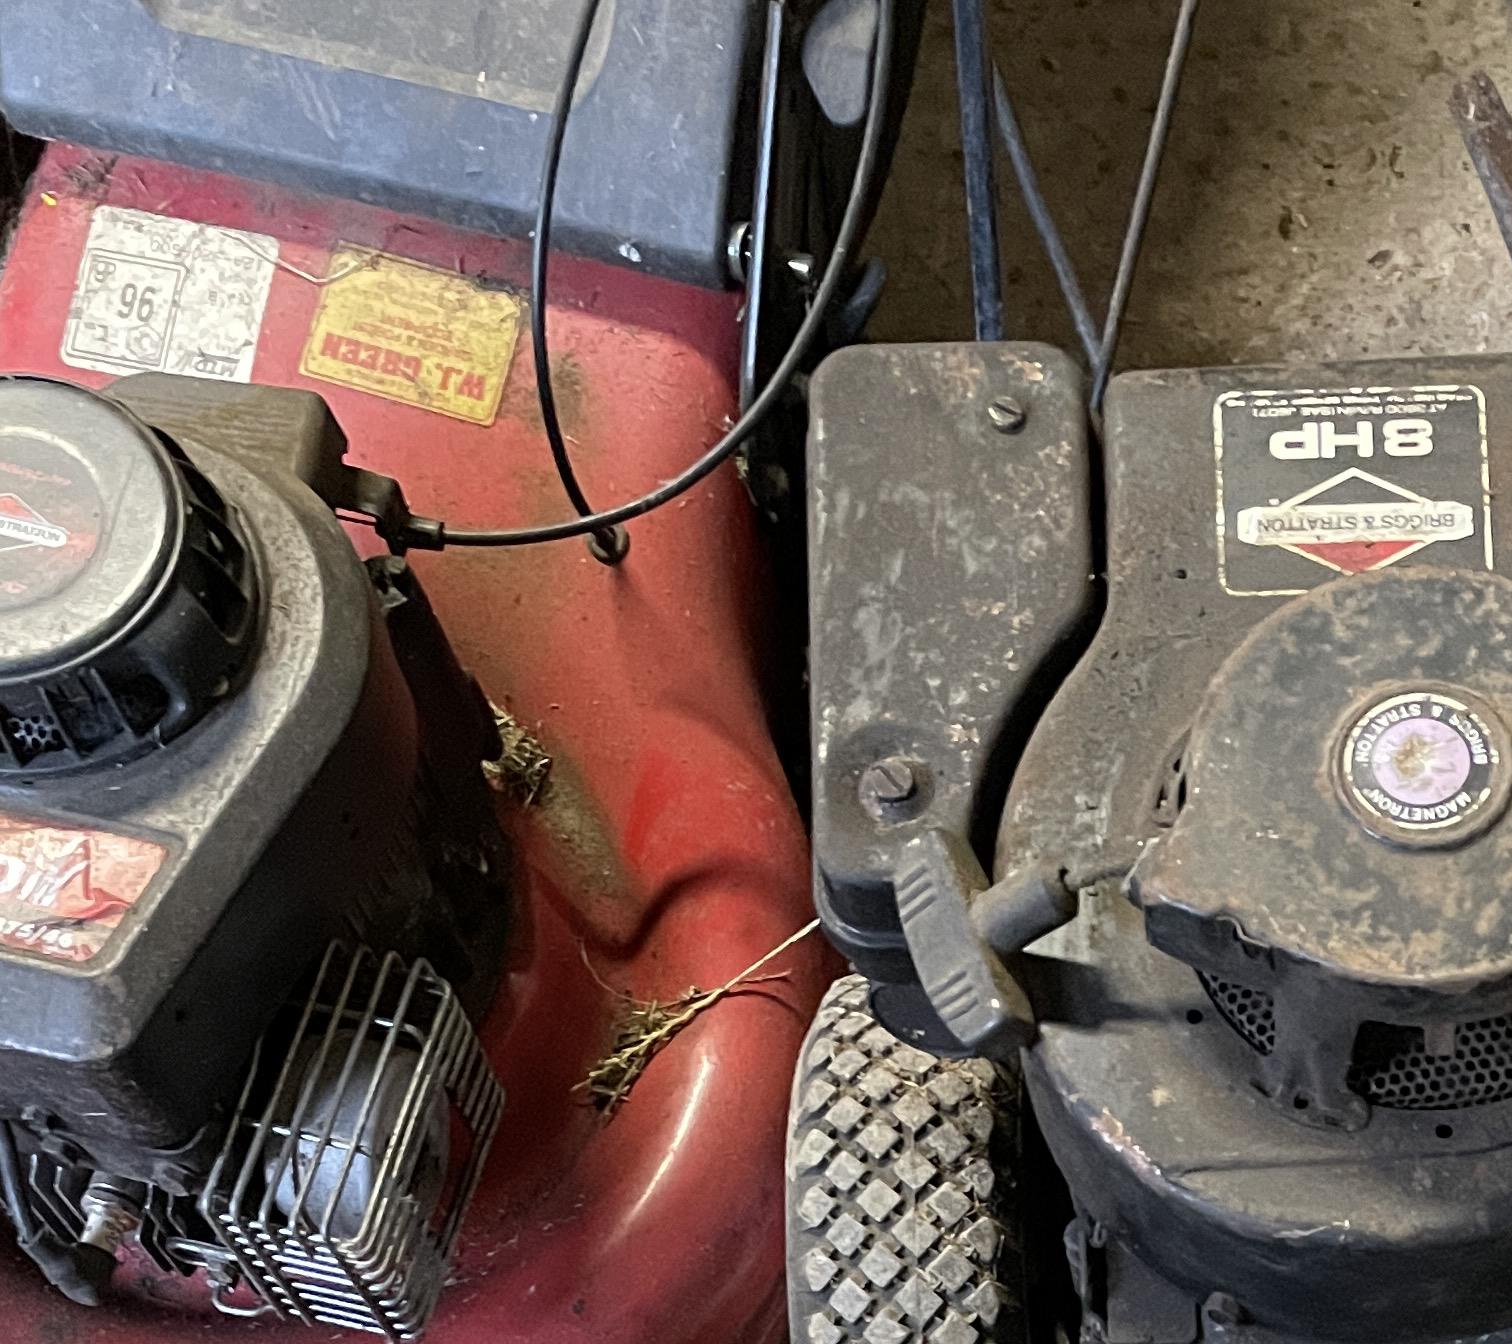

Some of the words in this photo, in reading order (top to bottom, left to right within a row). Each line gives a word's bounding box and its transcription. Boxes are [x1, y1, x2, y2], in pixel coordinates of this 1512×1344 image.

[1268, 420, 1374, 460] HP
[1256, 515, 1358, 532] STRATTON
[1363, 514, 1376, 529] &
[1382, 513, 1455, 528] BRIGGS
[1431, 705, 1443, 718] &
[1355, 703, 1421, 763] STRATTON
